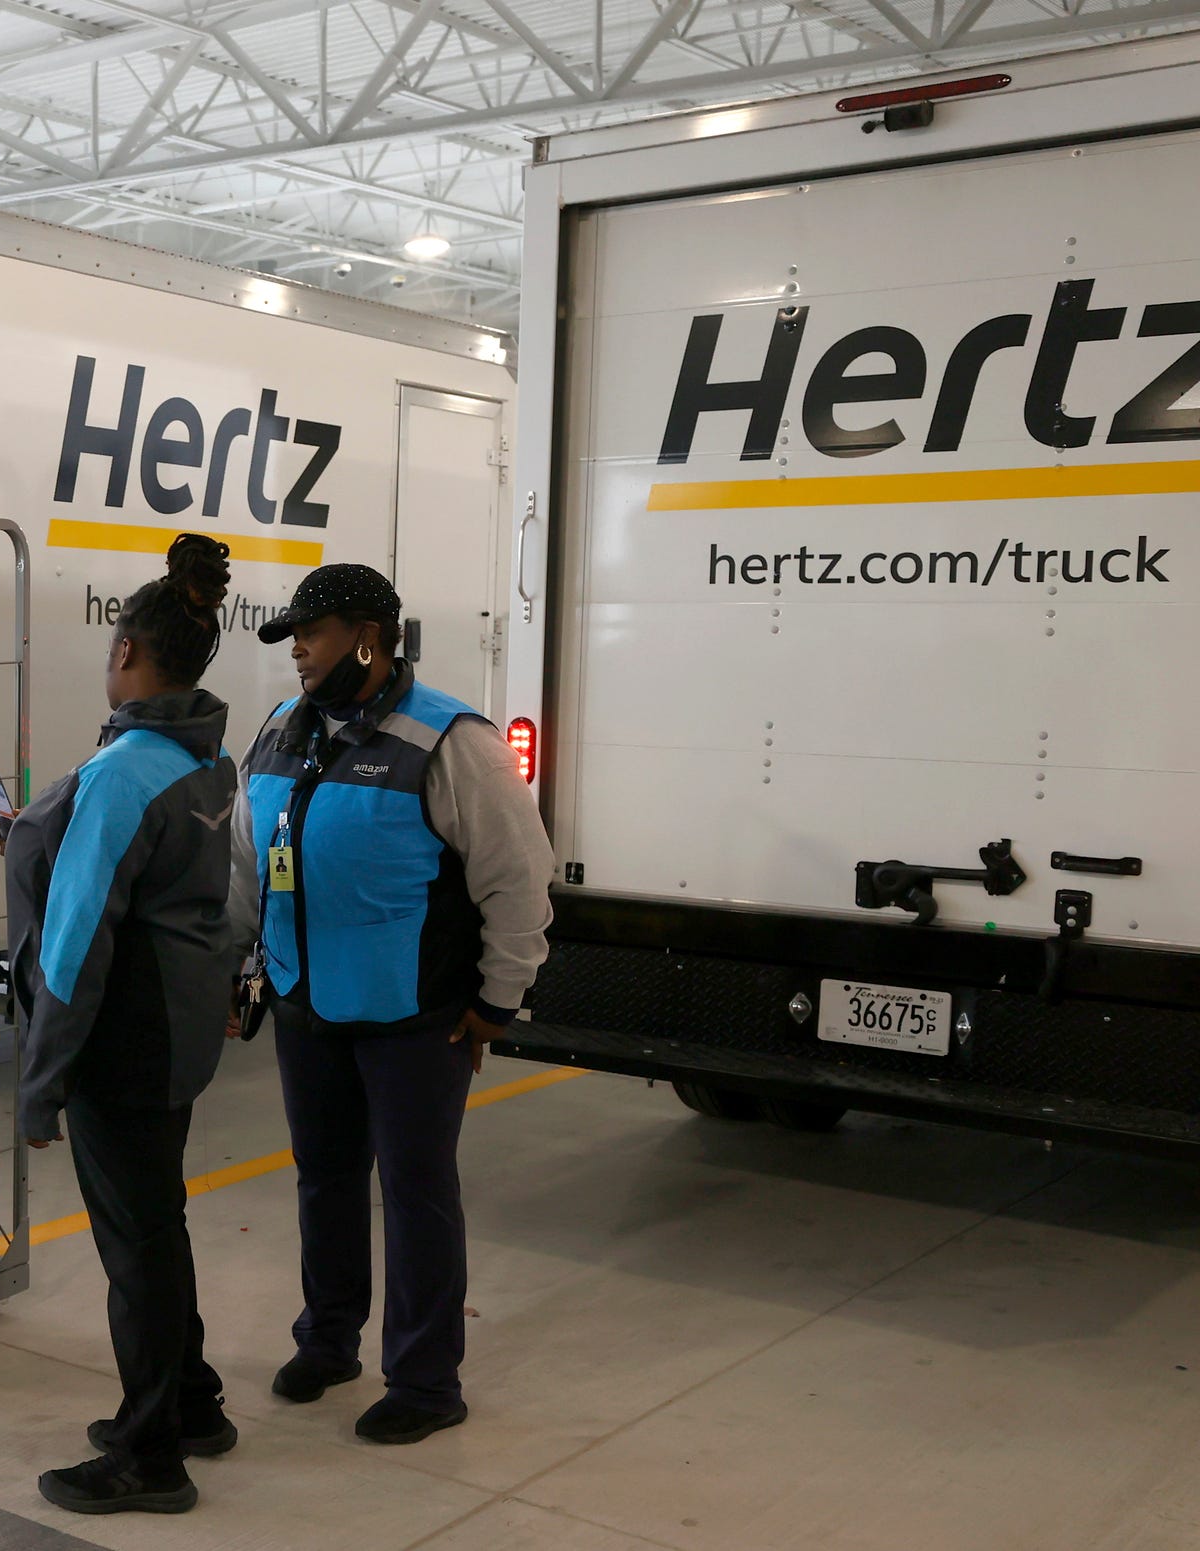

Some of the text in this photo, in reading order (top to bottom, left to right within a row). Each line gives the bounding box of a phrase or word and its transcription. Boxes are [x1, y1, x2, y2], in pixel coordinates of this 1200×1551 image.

[656, 278, 1200, 465] Hertz
[53, 354, 342, 528] Hertz
[708, 535, 1171, 586] hertz.com/truck
[353, 764, 389, 773] amazon
[848, 997, 925, 1034] 36675
[854, 986, 914, 1003] Tennessee
